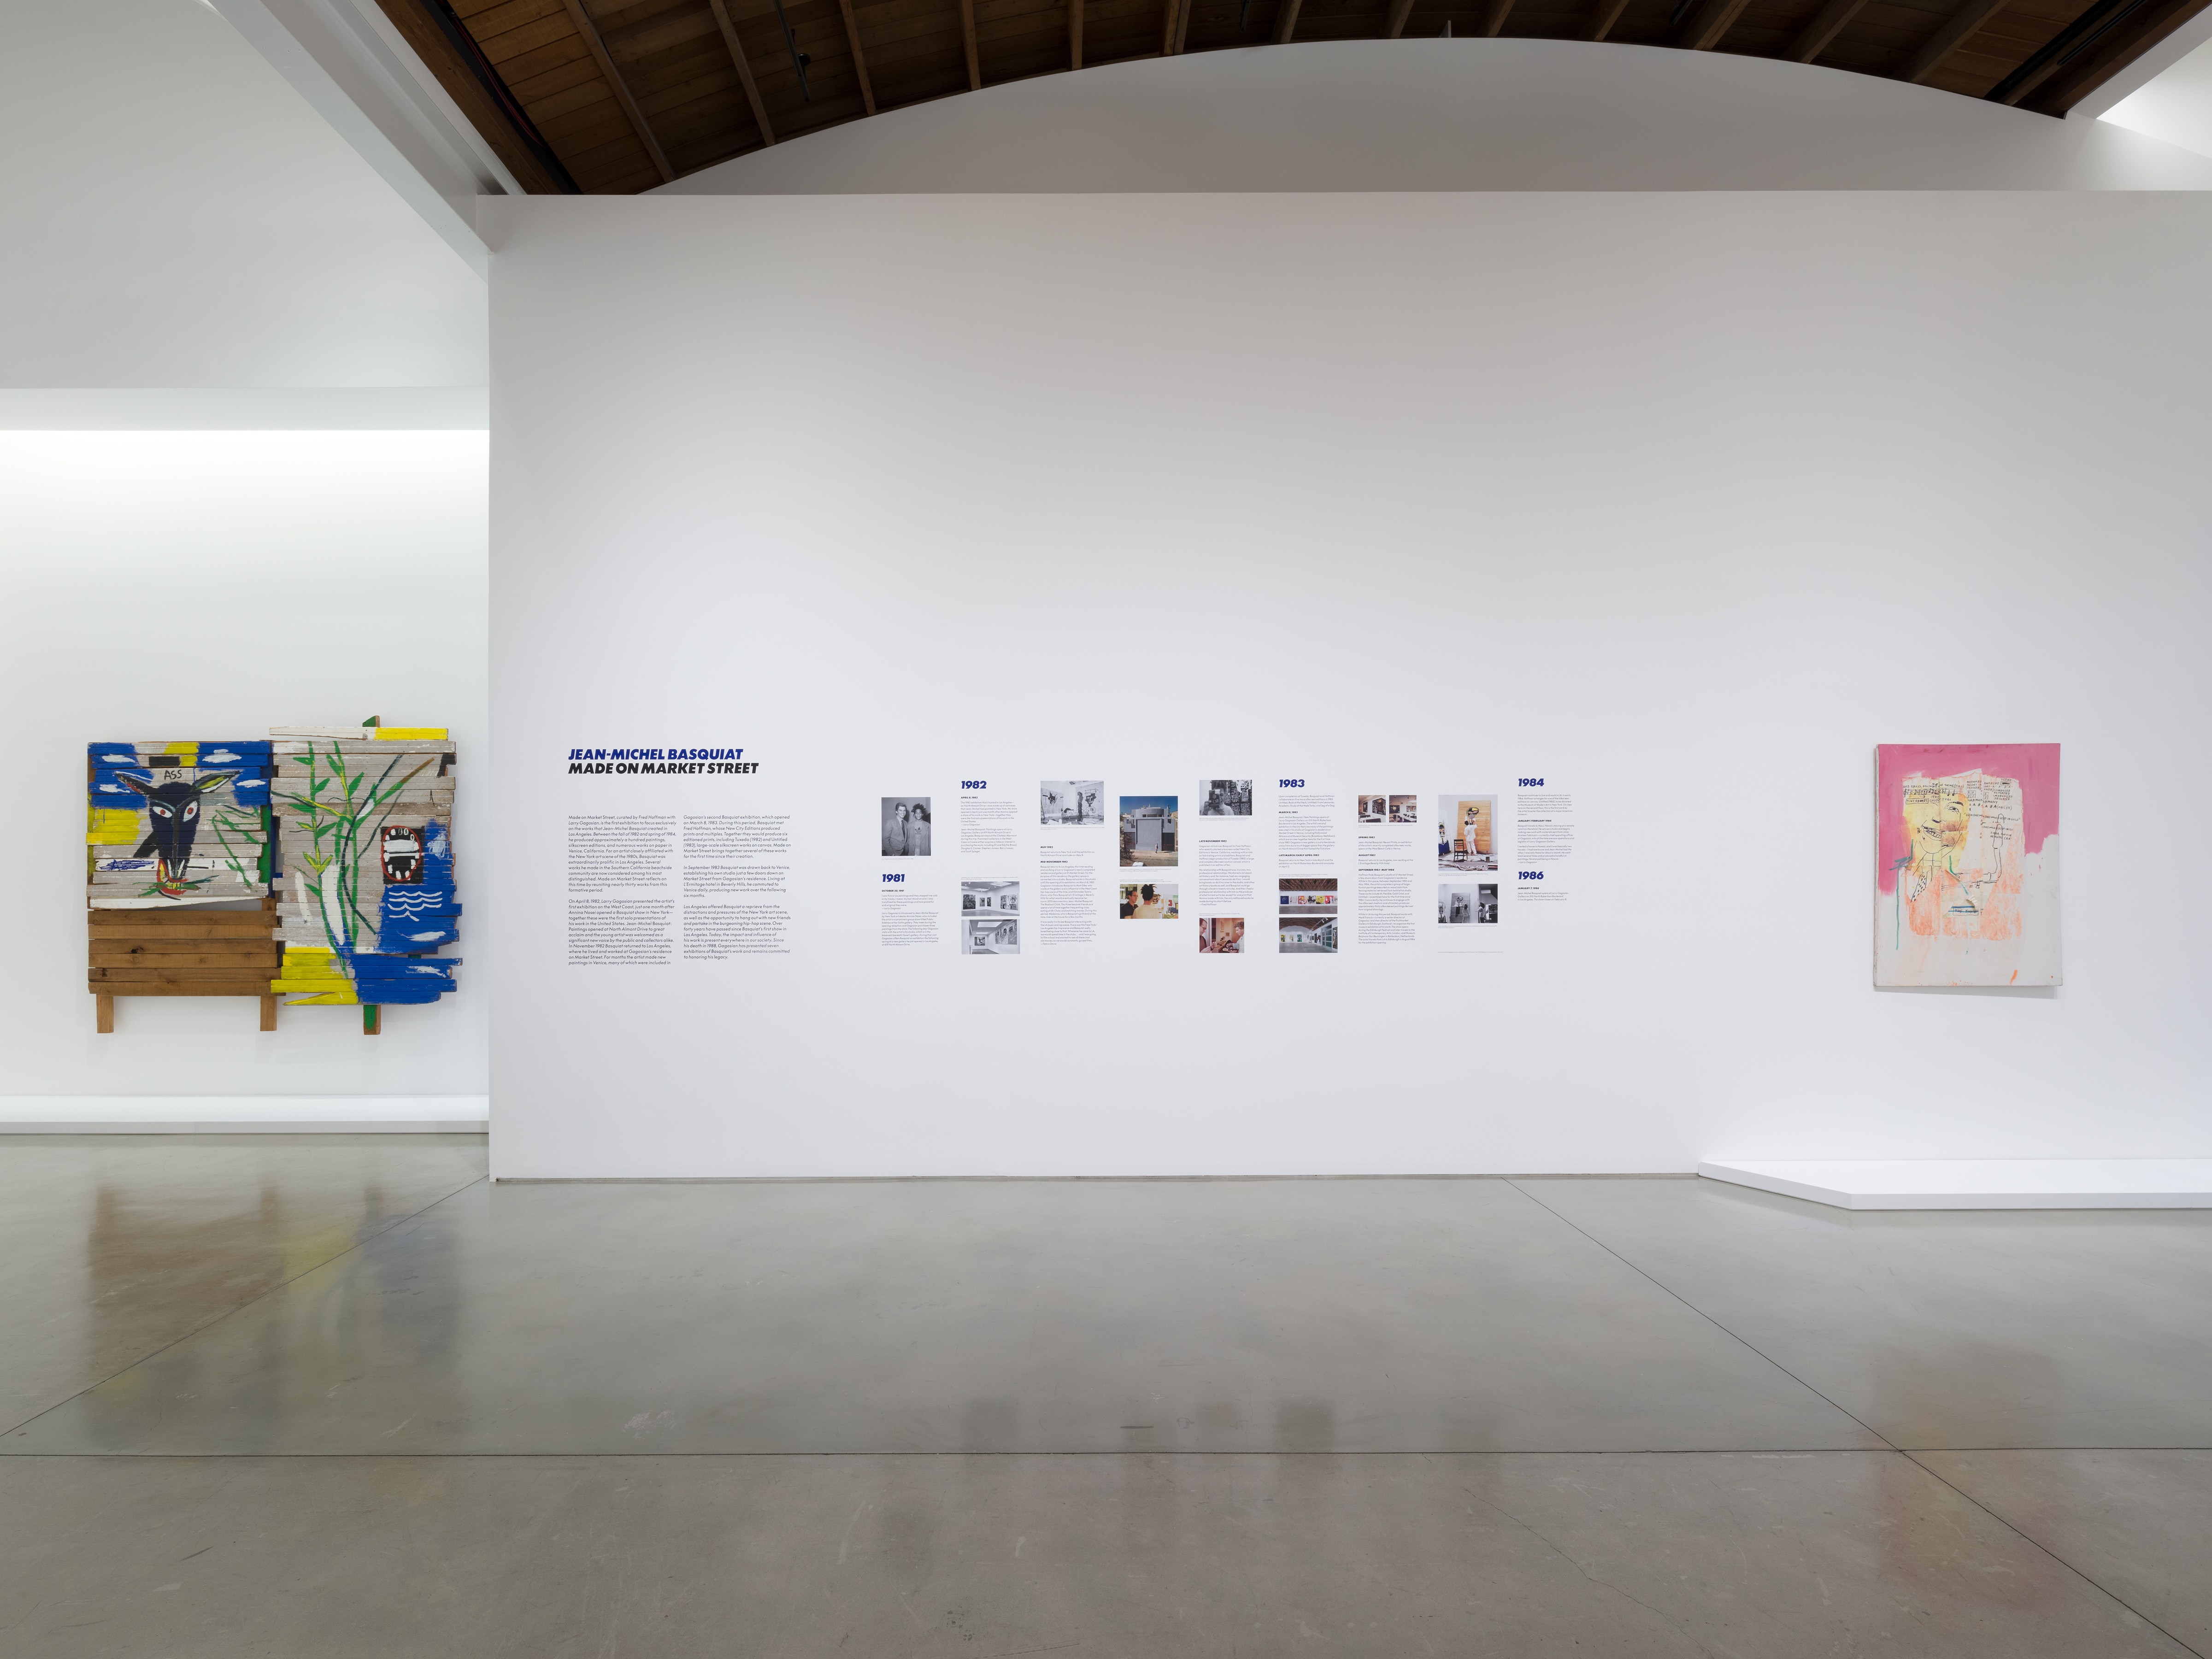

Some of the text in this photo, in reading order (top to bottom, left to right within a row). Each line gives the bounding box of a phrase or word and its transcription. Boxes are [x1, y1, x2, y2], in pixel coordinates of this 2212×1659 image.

[568, 749, 743, 760] JEAN-MICHEL BASQUIAT
[568, 763, 759, 774] MADE ON MARKET STREET
[164, 769, 182, 780] ASS
[961, 781, 987, 789] 1982
[1279, 779, 1305, 788] 1983
[1518, 778, 1544, 787] 1984
[882, 874, 905, 882] 1981
[1518, 871, 1544, 880] 1986
